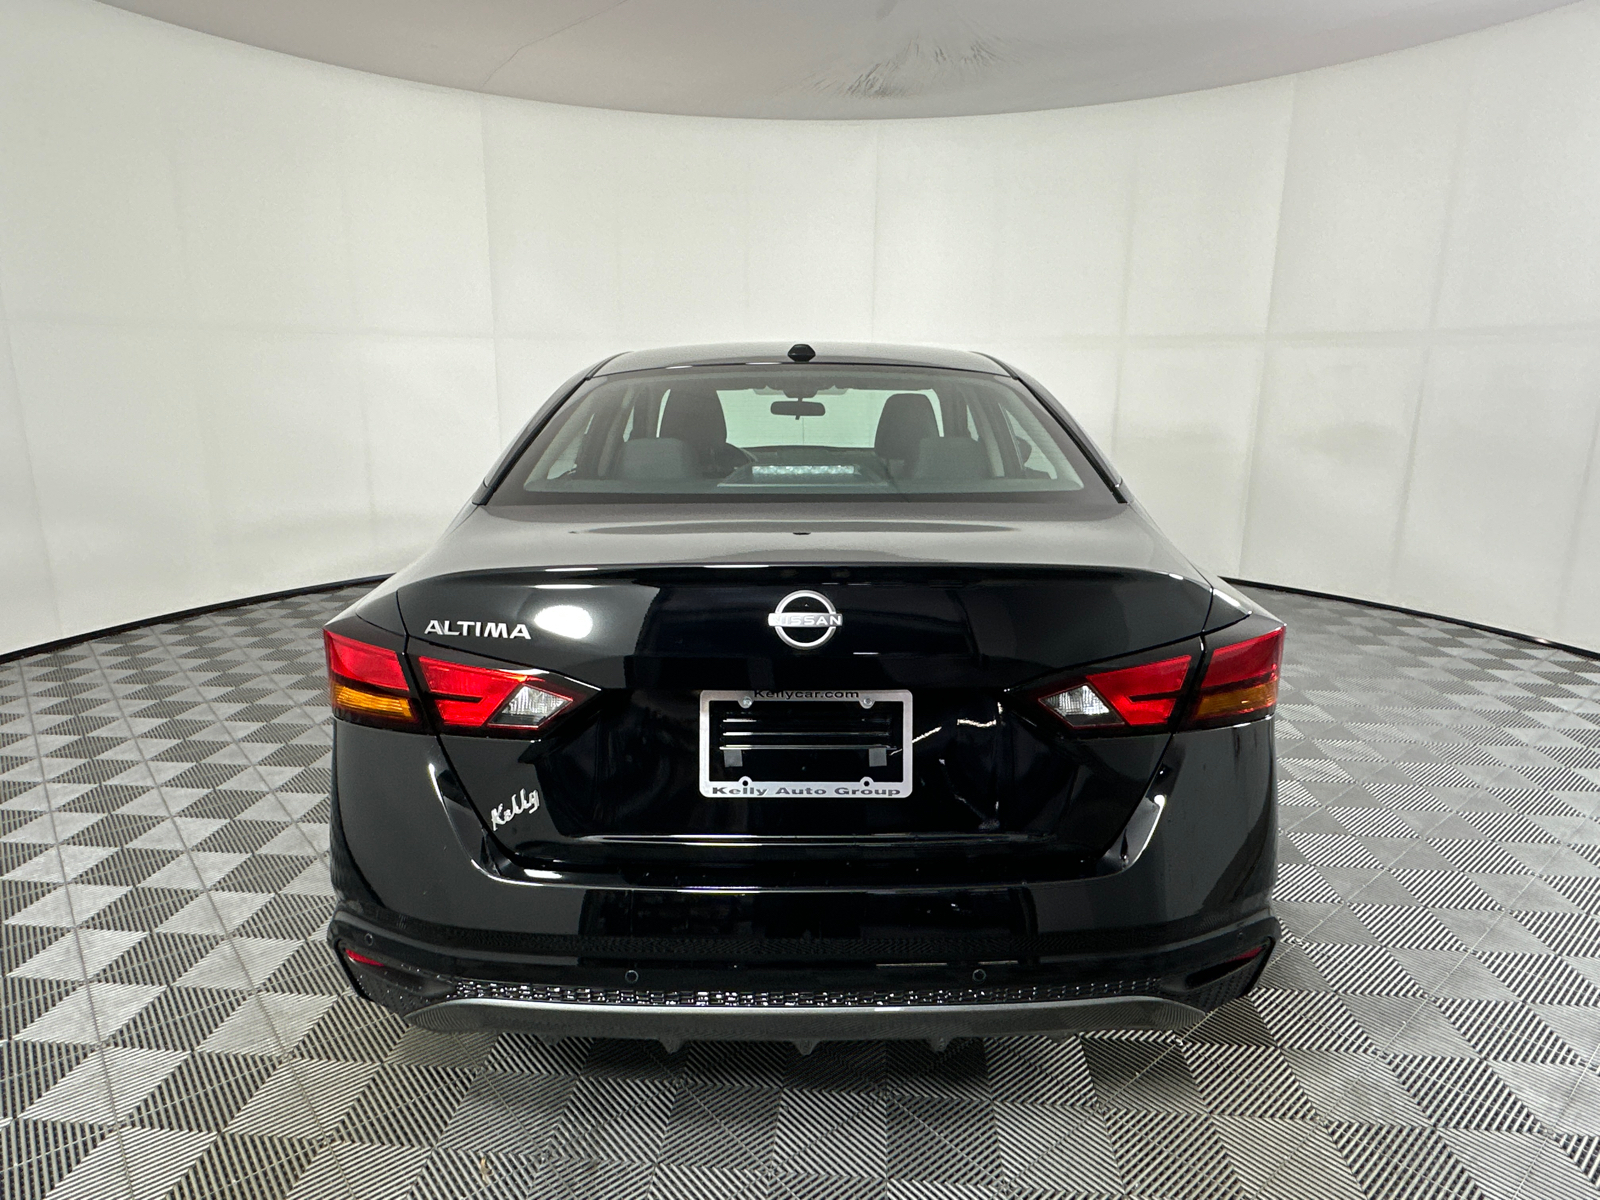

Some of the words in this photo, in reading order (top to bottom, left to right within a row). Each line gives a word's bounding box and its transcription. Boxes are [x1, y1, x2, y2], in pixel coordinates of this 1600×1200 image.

[424, 620, 532, 640] ALTIMA
[754, 690, 859, 699] Kellycar.com
[712, 787, 767, 796] Kelly
[775, 787, 827, 795] Auto
[834, 787, 901, 797] Group
[491, 788, 540, 831] Kelly
